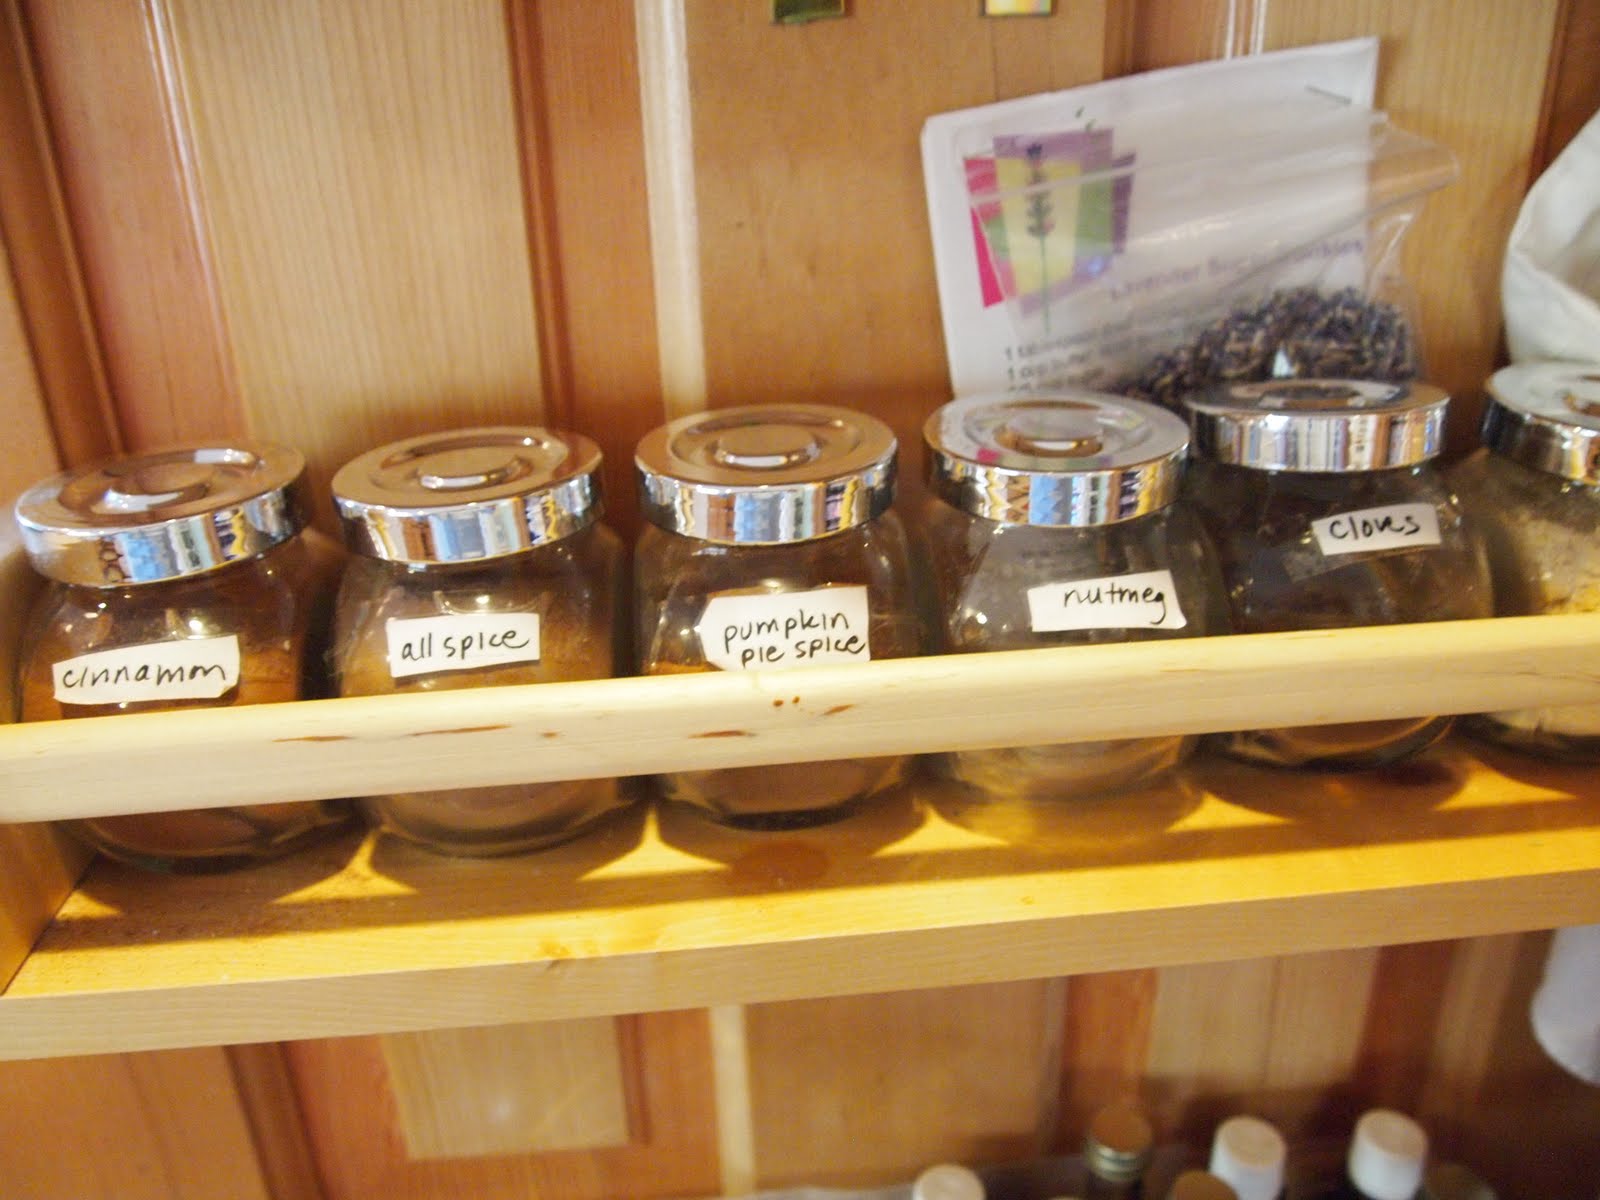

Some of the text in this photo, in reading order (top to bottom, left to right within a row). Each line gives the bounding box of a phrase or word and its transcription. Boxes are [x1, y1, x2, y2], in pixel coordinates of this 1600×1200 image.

[1063, 581, 1167, 626] nutmeg
[723, 608, 850, 655] pumpkin
[740, 634, 866, 669] pie spice
[62, 663, 227, 689] cinnamon
